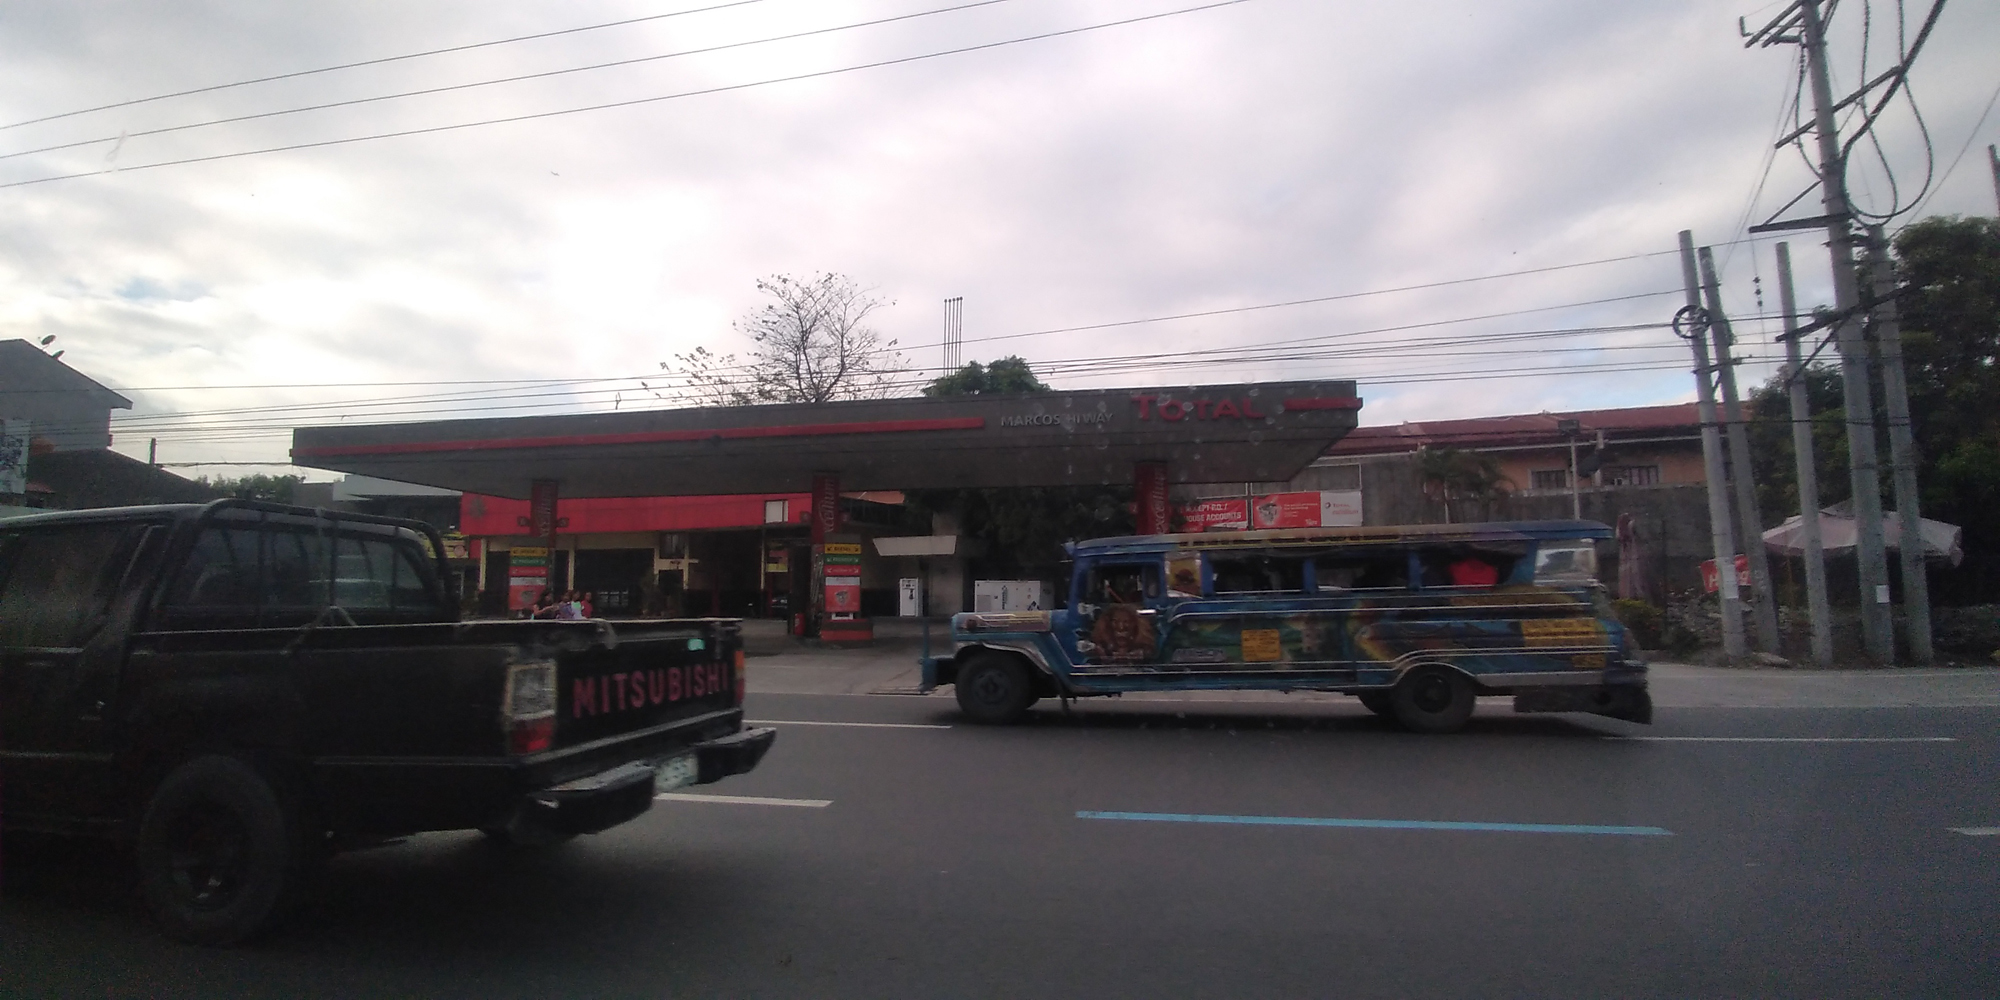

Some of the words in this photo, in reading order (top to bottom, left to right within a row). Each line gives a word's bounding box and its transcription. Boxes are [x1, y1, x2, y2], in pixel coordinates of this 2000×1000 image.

[1131, 395, 1266, 422] TOTAL
[1000, 413, 1061, 427] MARCOS
[1206, 511, 1242, 521] ACCOUNTS
[572, 662, 729, 718] MITSUBISHI
